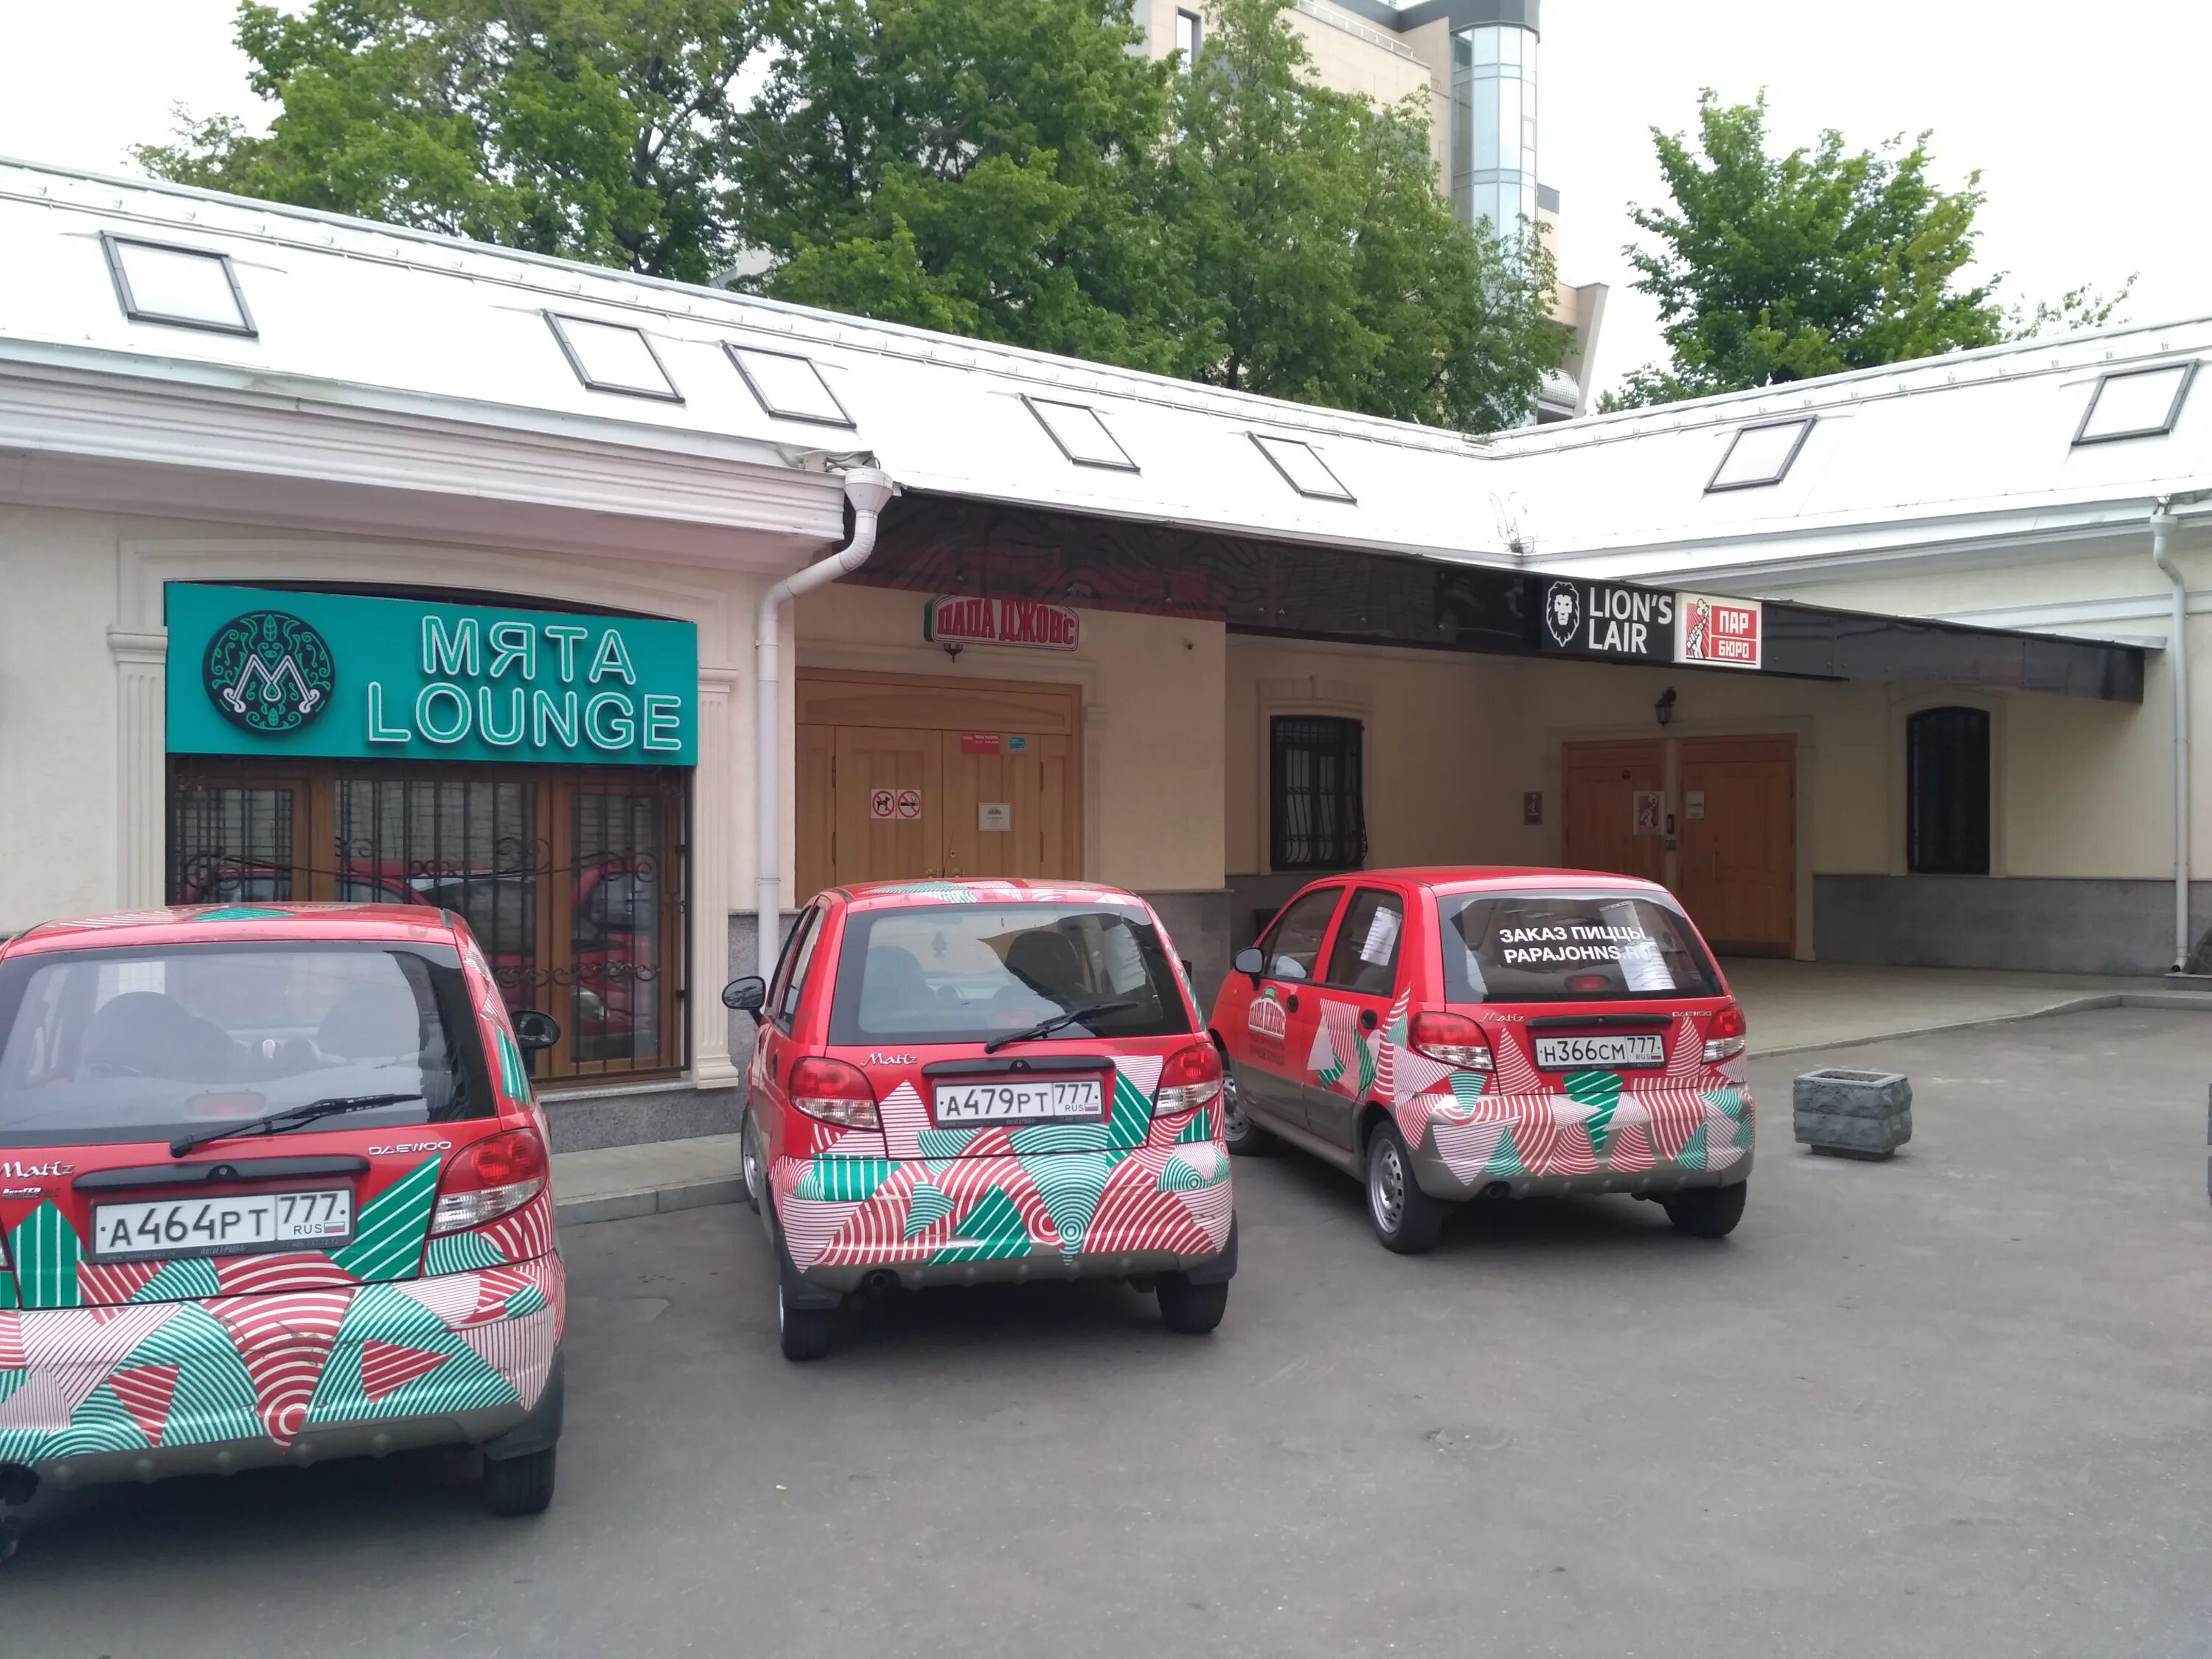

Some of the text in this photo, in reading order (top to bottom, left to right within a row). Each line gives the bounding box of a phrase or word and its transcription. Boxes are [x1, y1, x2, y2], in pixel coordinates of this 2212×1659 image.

[1589, 587, 1672, 625] LION'S
[937, 598, 995, 639] ПАПА
[1719, 610, 1749, 635] ПАР
[1588, 618, 1648, 654] LAIR
[422, 615, 636, 685] МЯТА
[1718, 639, 1750, 658] БЮРО
[369, 681, 682, 751] LOUNGE
[1499, 926, 1646, 943] ЗАКАЗ ПИЦЦЫ
[1478, 1012, 1524, 1023] Matiz
[1627, 1037, 1655, 1054] 777
[861, 1052, 918, 1068] Matiz
[1054, 1083, 1093, 1105] 777
[1065, 1104, 1085, 1112] RUS
[368, 1141, 452, 1155] DAEWOO
[0, 1161, 74, 1178] Matiz
[279, 1193, 338, 1225] 777
[293, 1224, 323, 1235] RUS
